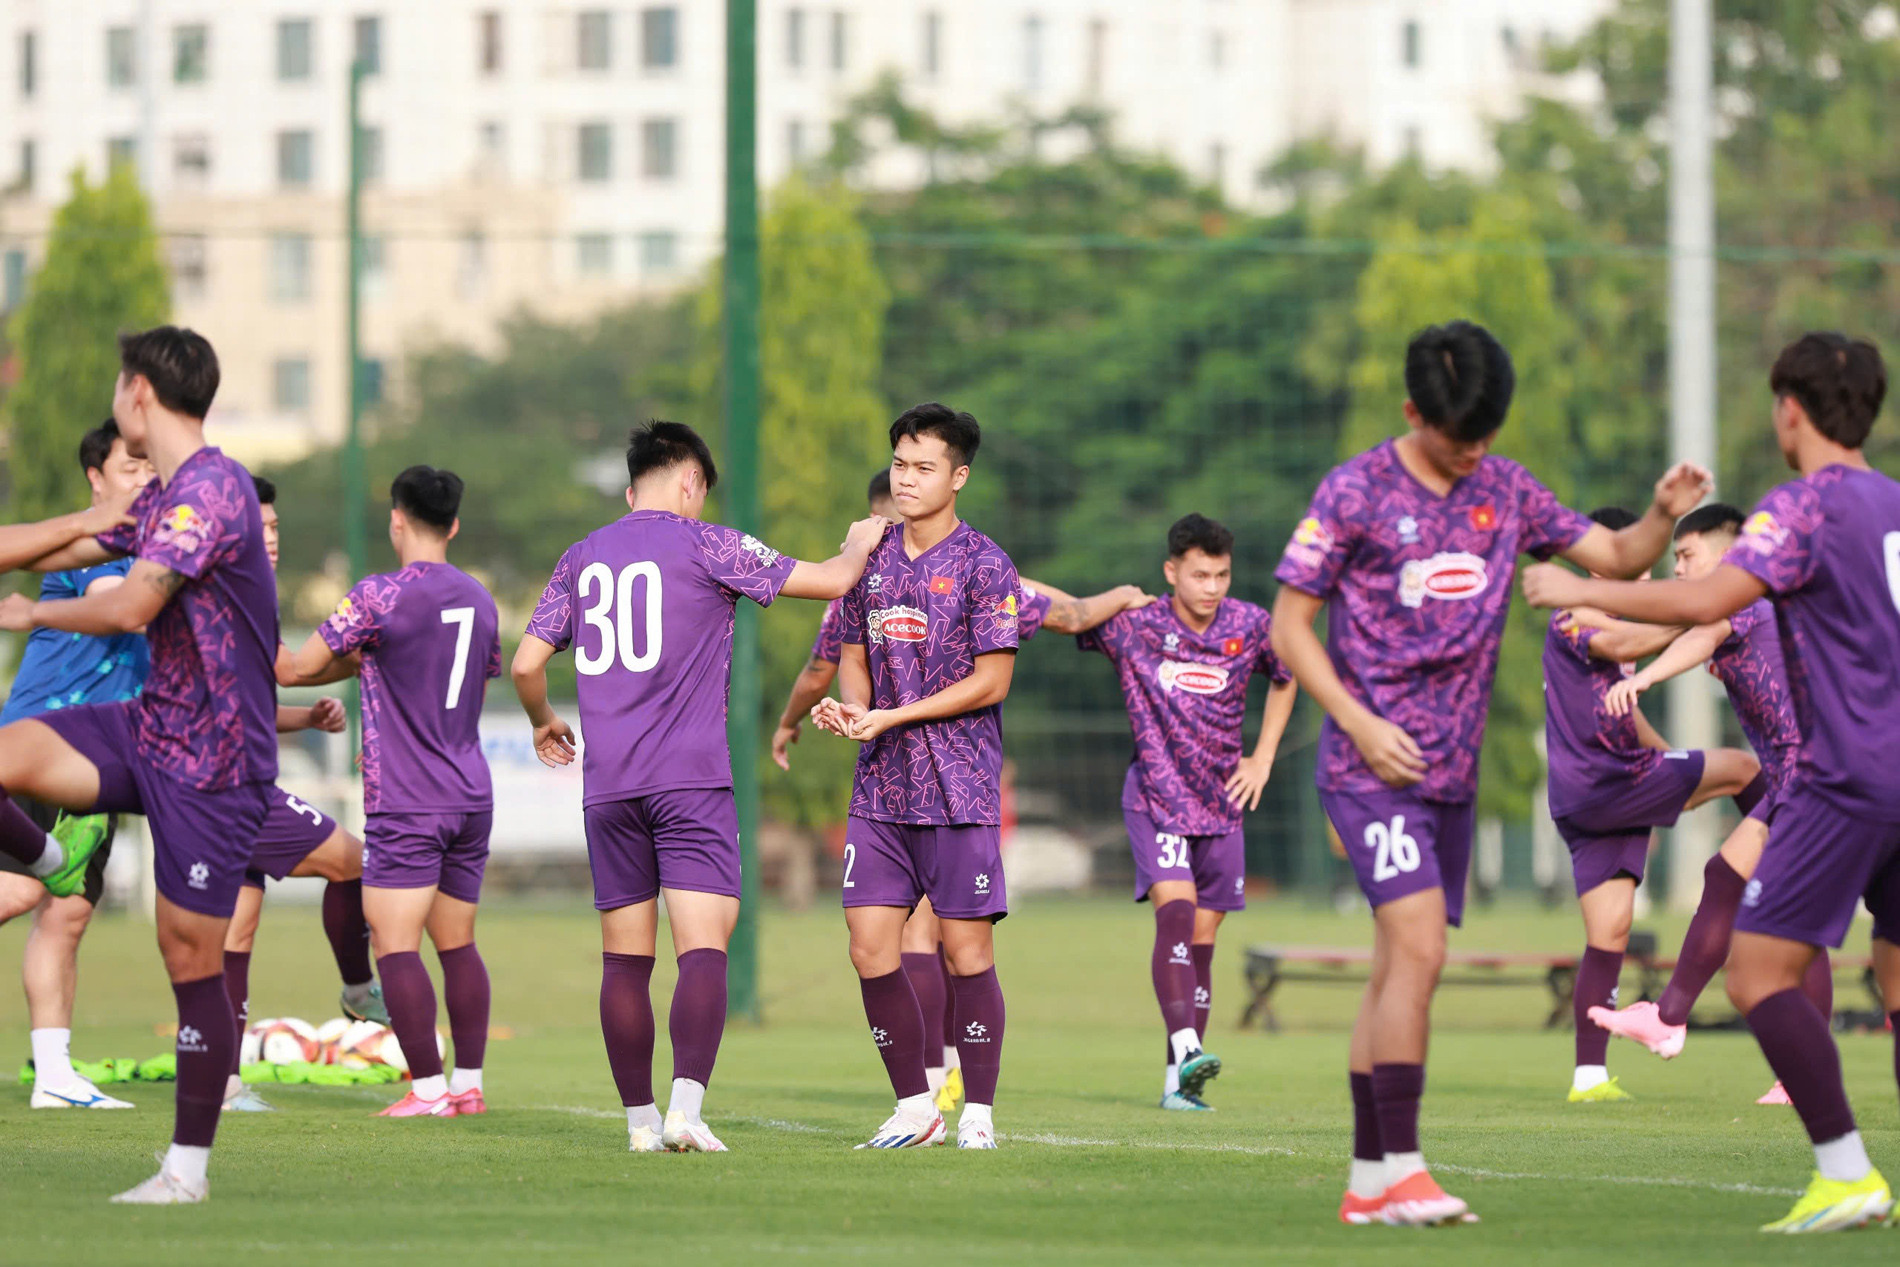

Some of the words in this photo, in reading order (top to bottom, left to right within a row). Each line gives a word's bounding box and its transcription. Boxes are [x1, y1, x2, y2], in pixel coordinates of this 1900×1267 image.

[575, 560, 663, 676] 30
[880, 606, 900, 619] Cook
[440, 606, 475, 710] 7
[285, 795, 323, 826] 5
[842, 843, 856, 888] 2
[1155, 831, 1190, 869] 32
[1363, 814, 1421, 883] 26
